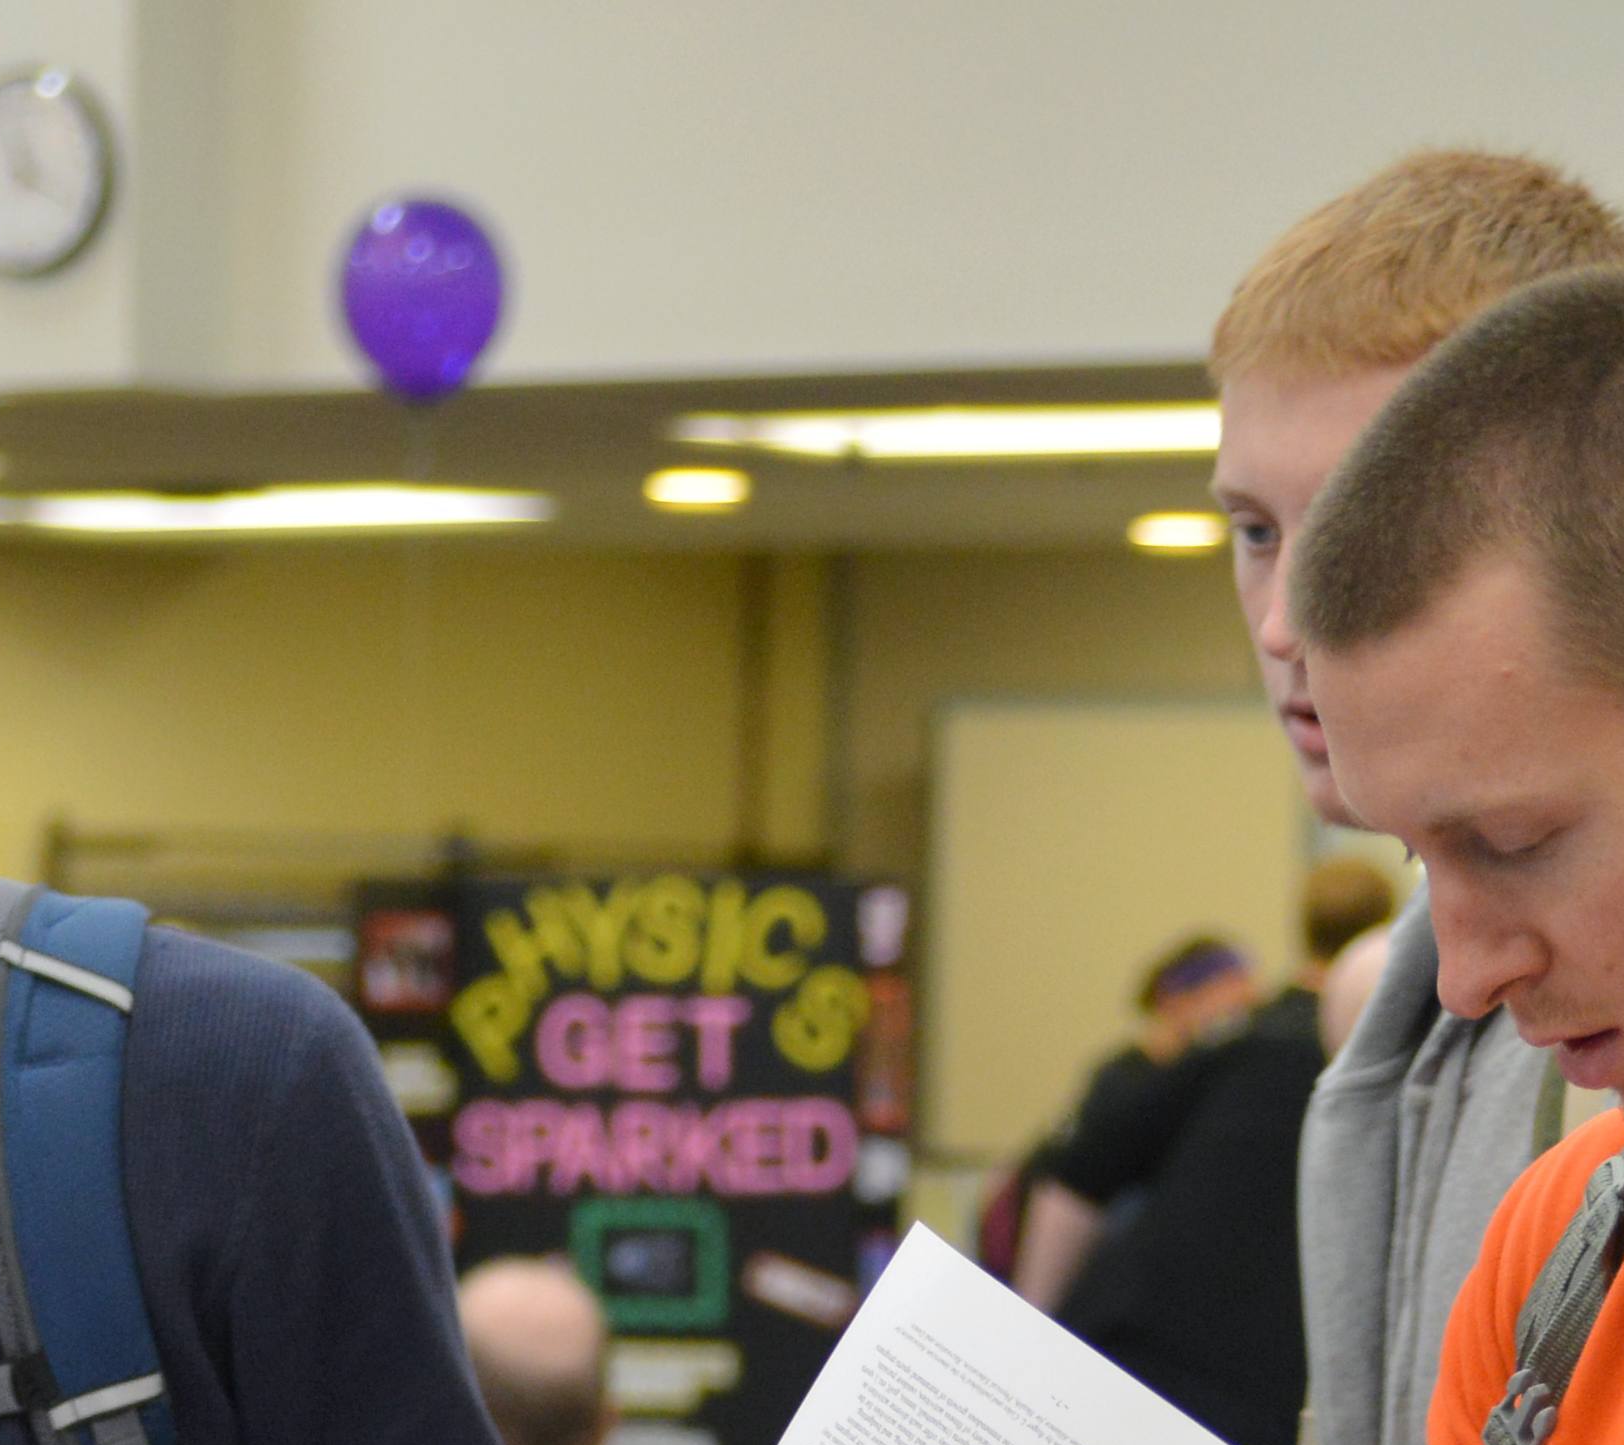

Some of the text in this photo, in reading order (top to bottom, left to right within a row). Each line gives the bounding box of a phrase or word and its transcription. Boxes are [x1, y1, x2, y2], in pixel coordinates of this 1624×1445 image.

[452, 876, 870, 1082] PHYSICS
[535, 995, 752, 1092] GET
[452, 1098, 860, 1195] SPARKED
